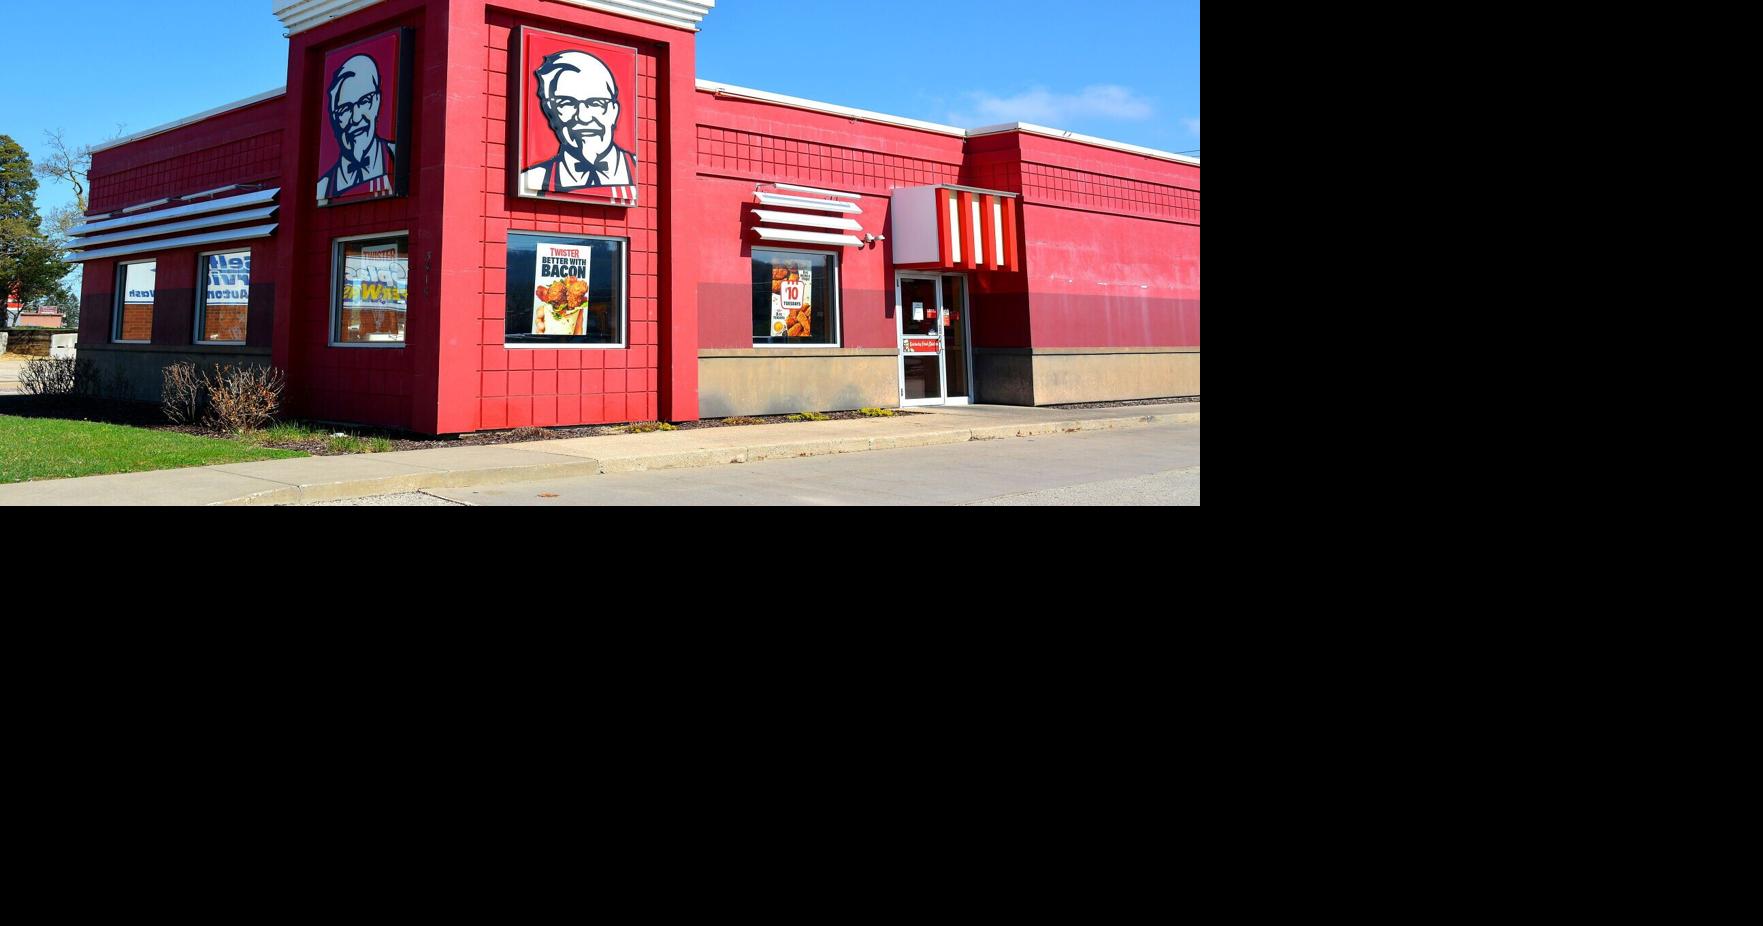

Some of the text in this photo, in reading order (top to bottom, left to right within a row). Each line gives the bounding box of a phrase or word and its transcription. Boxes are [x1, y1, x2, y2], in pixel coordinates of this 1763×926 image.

[550, 247, 579, 258] TWISTER
[542, 256, 587, 266] BETTER WITH
[541, 264, 586, 279] BACON
